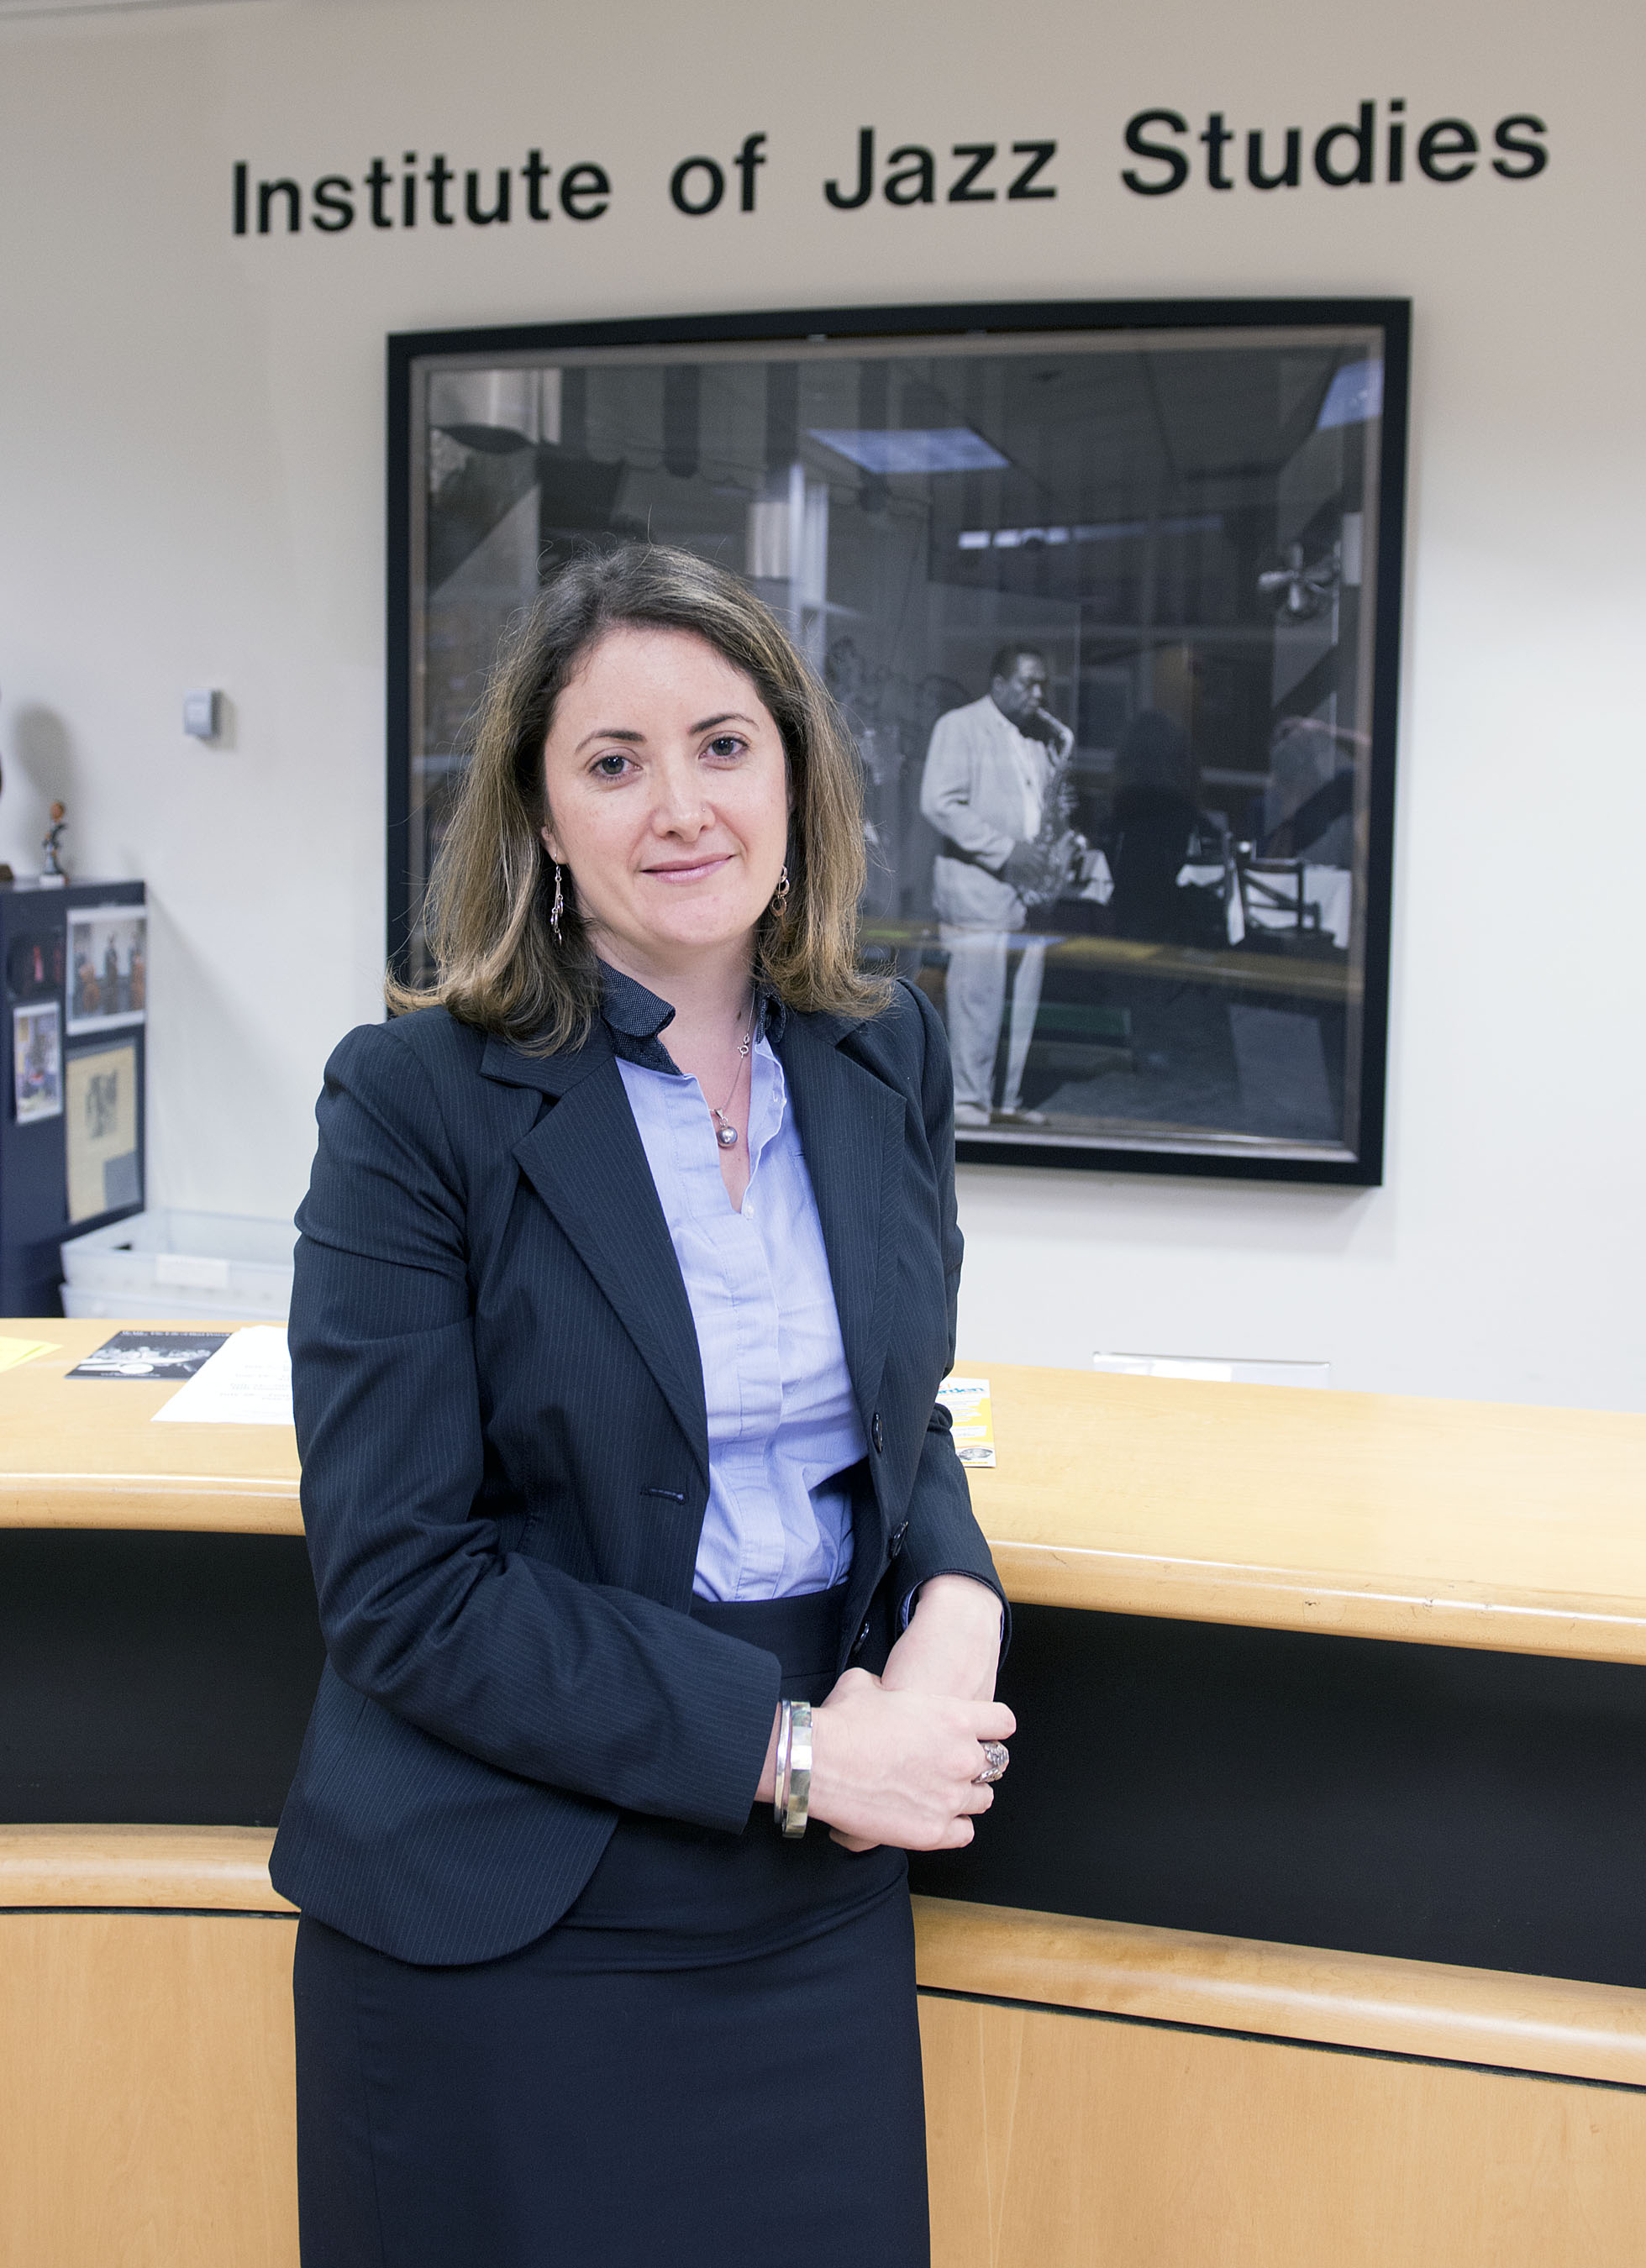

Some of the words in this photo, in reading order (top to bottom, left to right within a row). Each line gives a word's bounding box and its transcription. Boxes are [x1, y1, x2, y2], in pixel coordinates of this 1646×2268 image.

[233, 147, 613, 237] Institute
[667, 132, 768, 218] of
[823, 126, 1058, 212] Jazz
[1120, 97, 1549, 198] Studies
